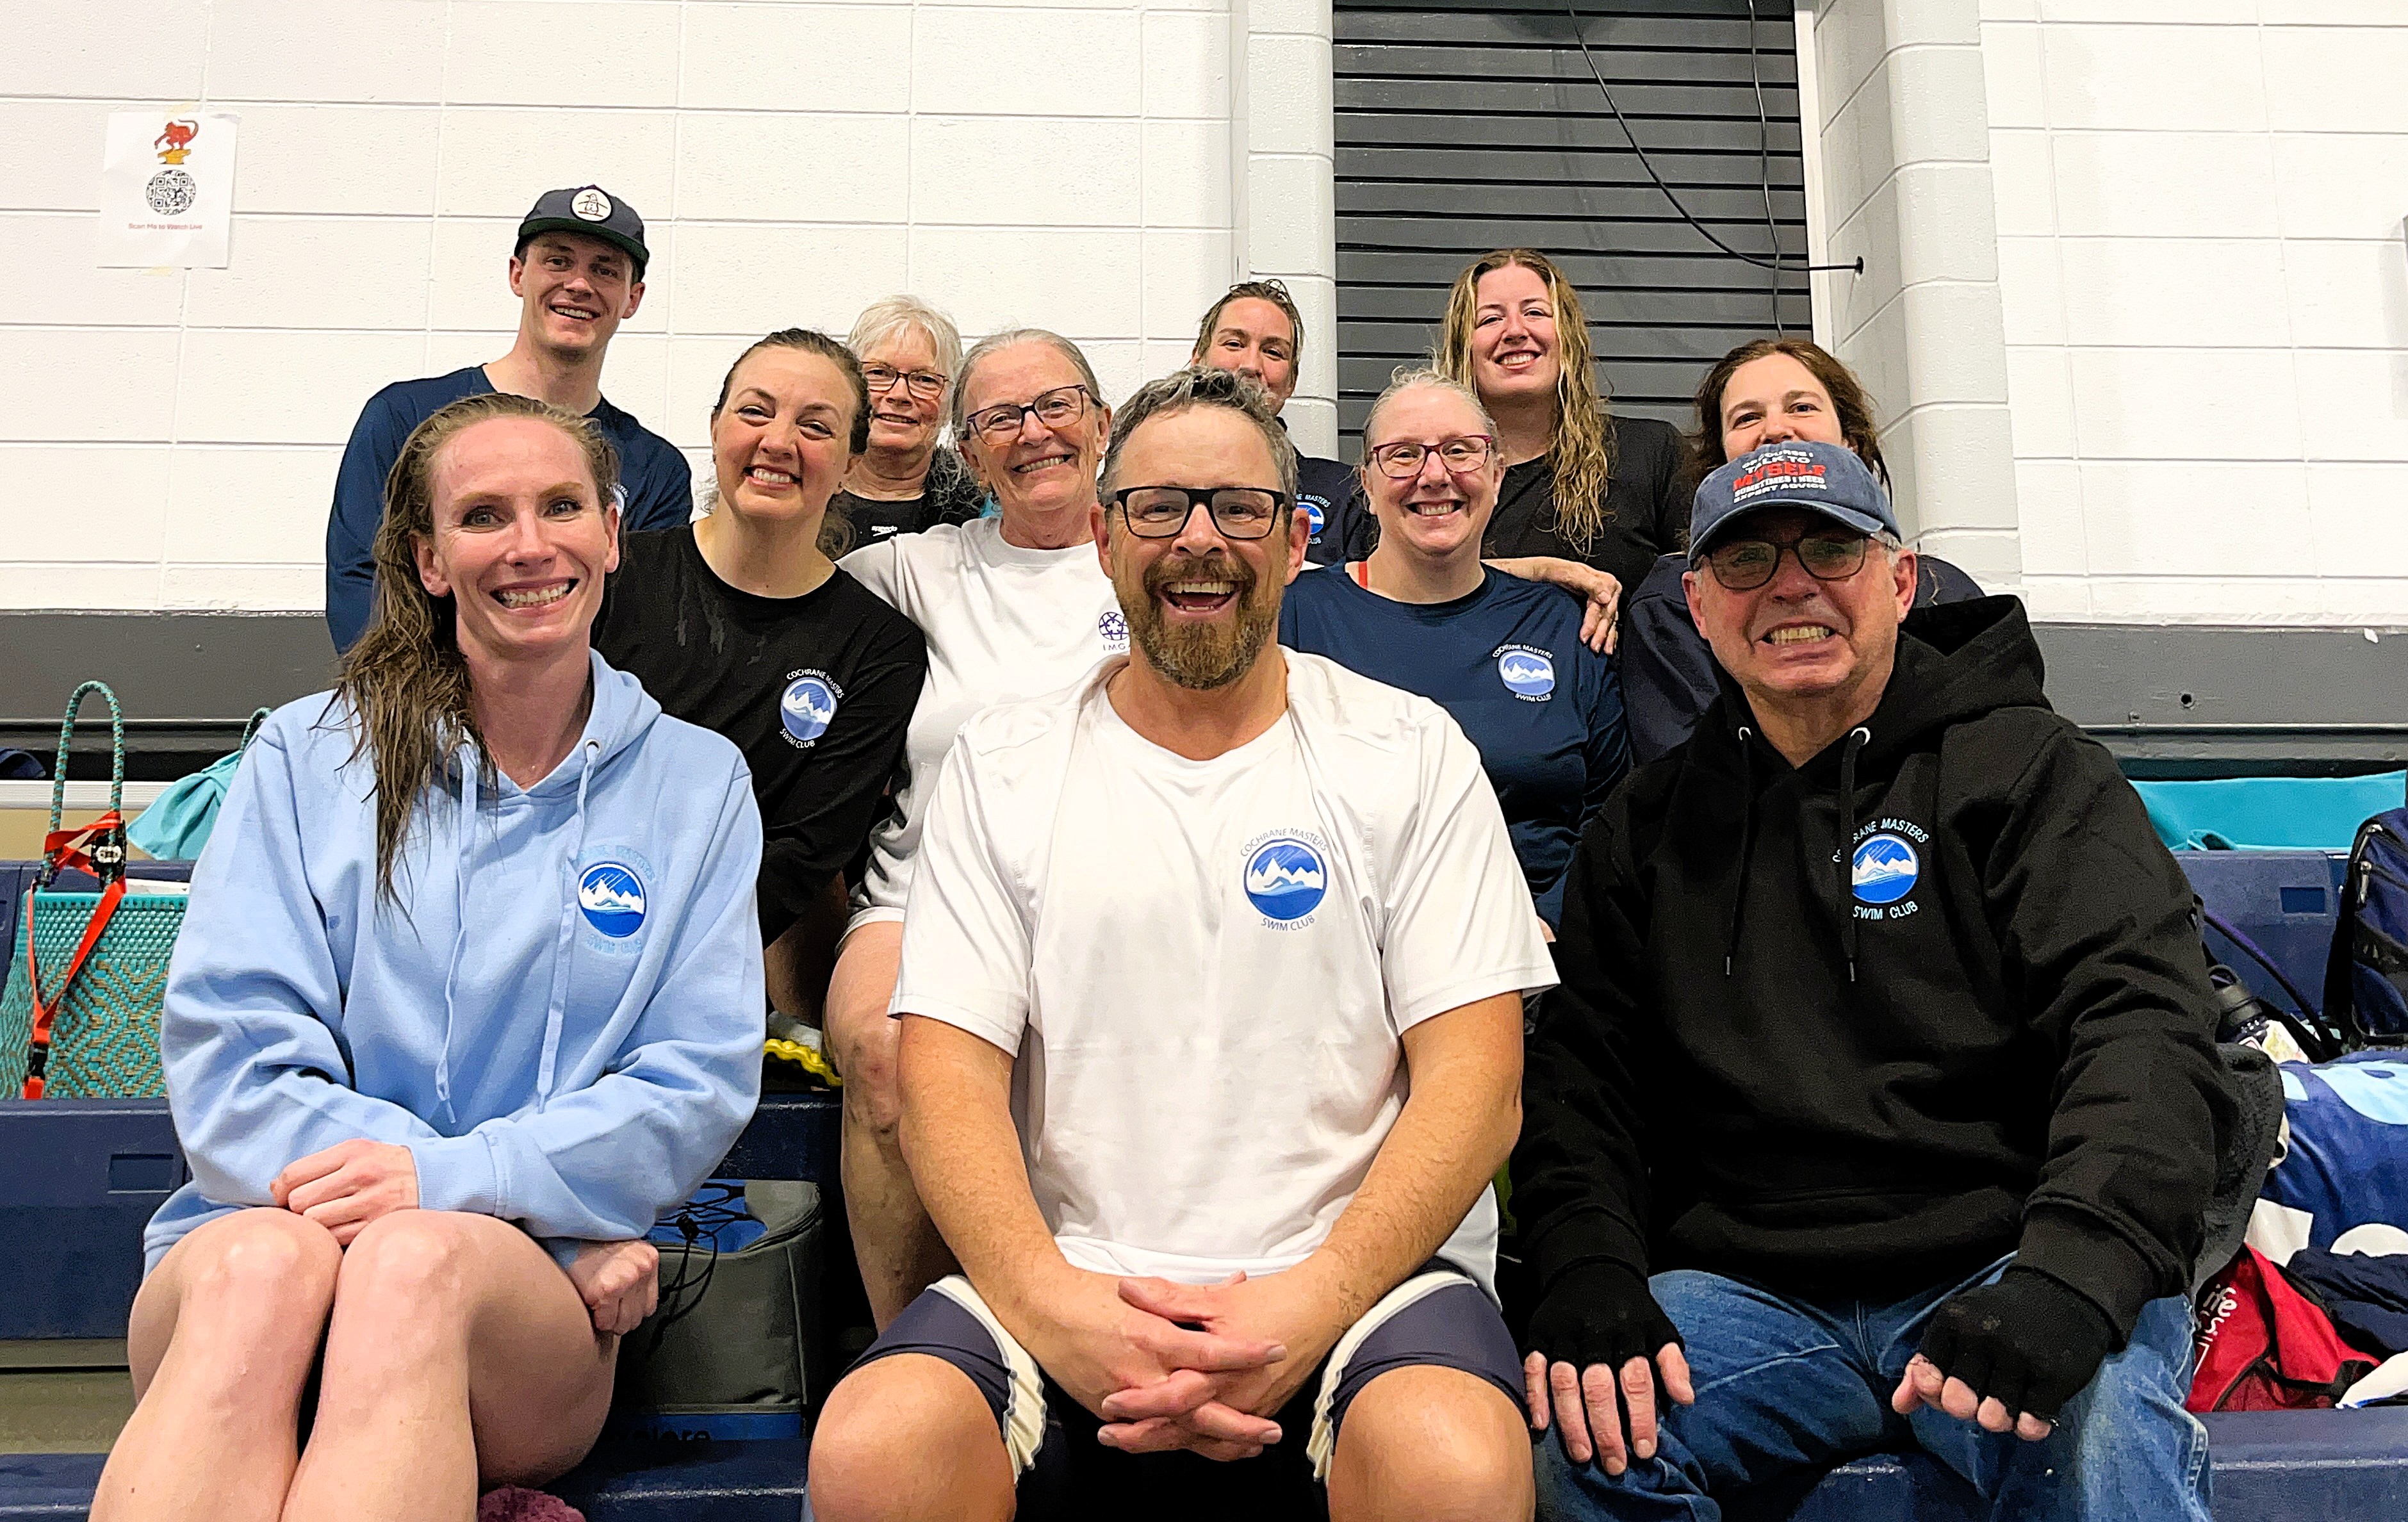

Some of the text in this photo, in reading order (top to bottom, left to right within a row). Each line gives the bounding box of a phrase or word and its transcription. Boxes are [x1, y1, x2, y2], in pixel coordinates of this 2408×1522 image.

[1742, 459, 1758, 469] OF
[1758, 449, 1808, 461] COURSE
[1745, 455, 1810, 474] TALK TO
[1733, 461, 1826, 492] MYSELF
[1734, 475, 1791, 497] SOMETIMES
[1798, 475, 1825, 484] NEED
[1305, 493, 1332, 508] MASTERS
[1733, 484, 1778, 503] EXPERT
[1492, 644, 1553, 659] COCHRANE MASTERS
[786, 668, 845, 699] COCHRANE MASTERS
[1514, 692, 1552, 702] SWIM CLUB
[779, 728, 815, 749] SWIM CLUB
[1880, 817, 1929, 844] MASTERS
[1240, 827, 1328, 857] COCHRANE MASTERS
[1852, 901, 1919, 921] SWIM CLUB
[1260, 914, 1315, 931] SWIM CLUB
